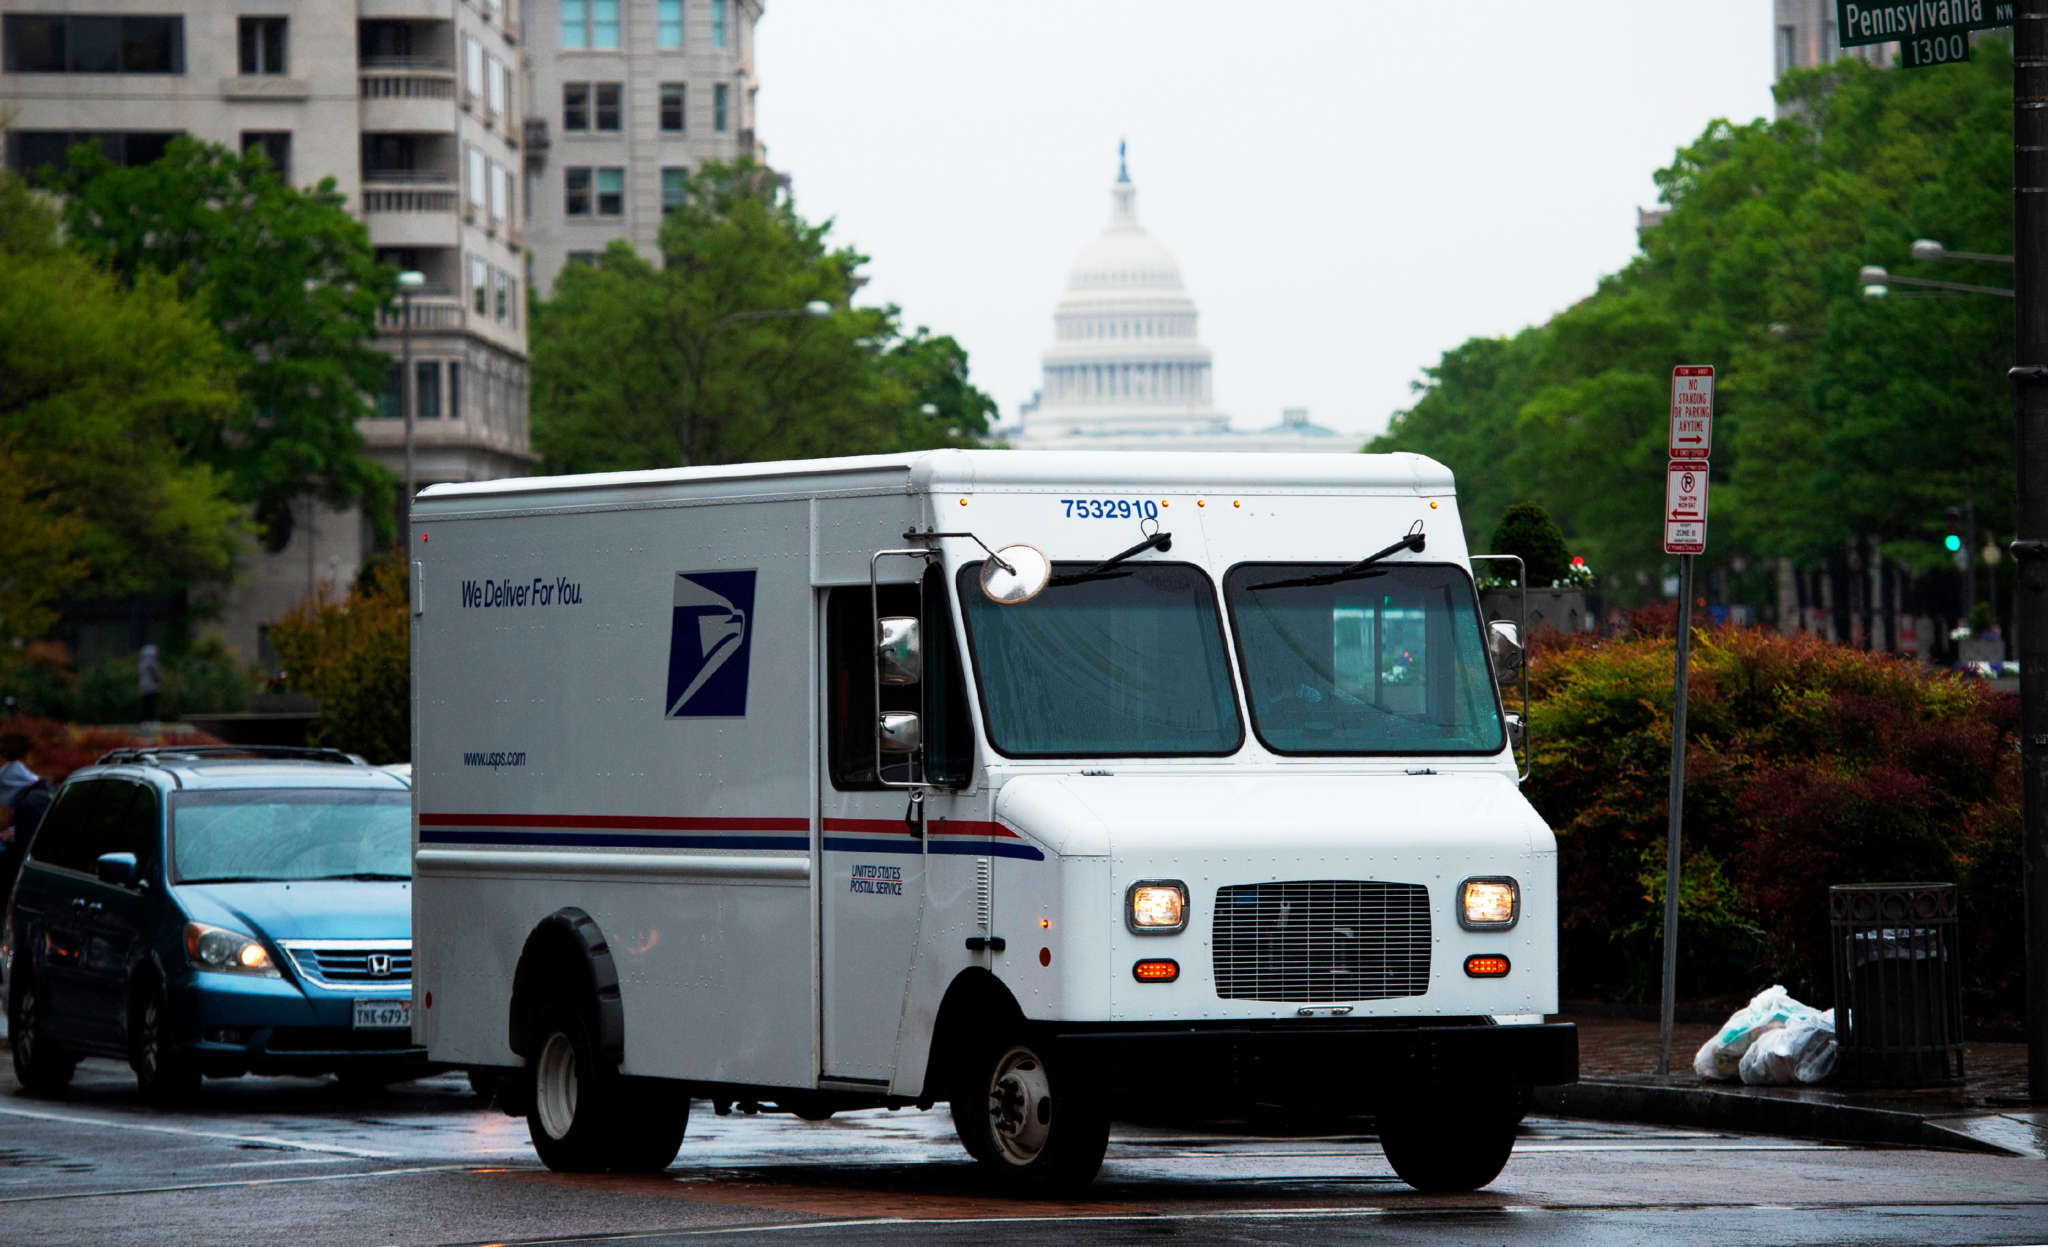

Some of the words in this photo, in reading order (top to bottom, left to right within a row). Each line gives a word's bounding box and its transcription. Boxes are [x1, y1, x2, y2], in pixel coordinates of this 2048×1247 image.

[1846, 0, 1983, 38] Pennsylvania
[1996, 4, 2014, 21] NW
[1911, 34, 1964, 65] 1300
[1688, 378, 1698, 391] NO
[1678, 392, 1707, 405] STANDING
[1685, 406, 1710, 418] PARKING
[1679, 420, 1704, 433] ANYTIME
[1060, 499, 1158, 519] 7532910
[462, 580, 482, 608] We
[484, 578, 530, 608] Deliver
[532, 577, 554, 606] For
[556, 576, 583, 605] You.
[463, 751, 526, 770] www.usps.com
[852, 864, 877, 878] UNITED
[878, 865, 901, 880] STATES
[850, 880, 875, 894] POSTAL
[876, 881, 902, 896] SERVICE
